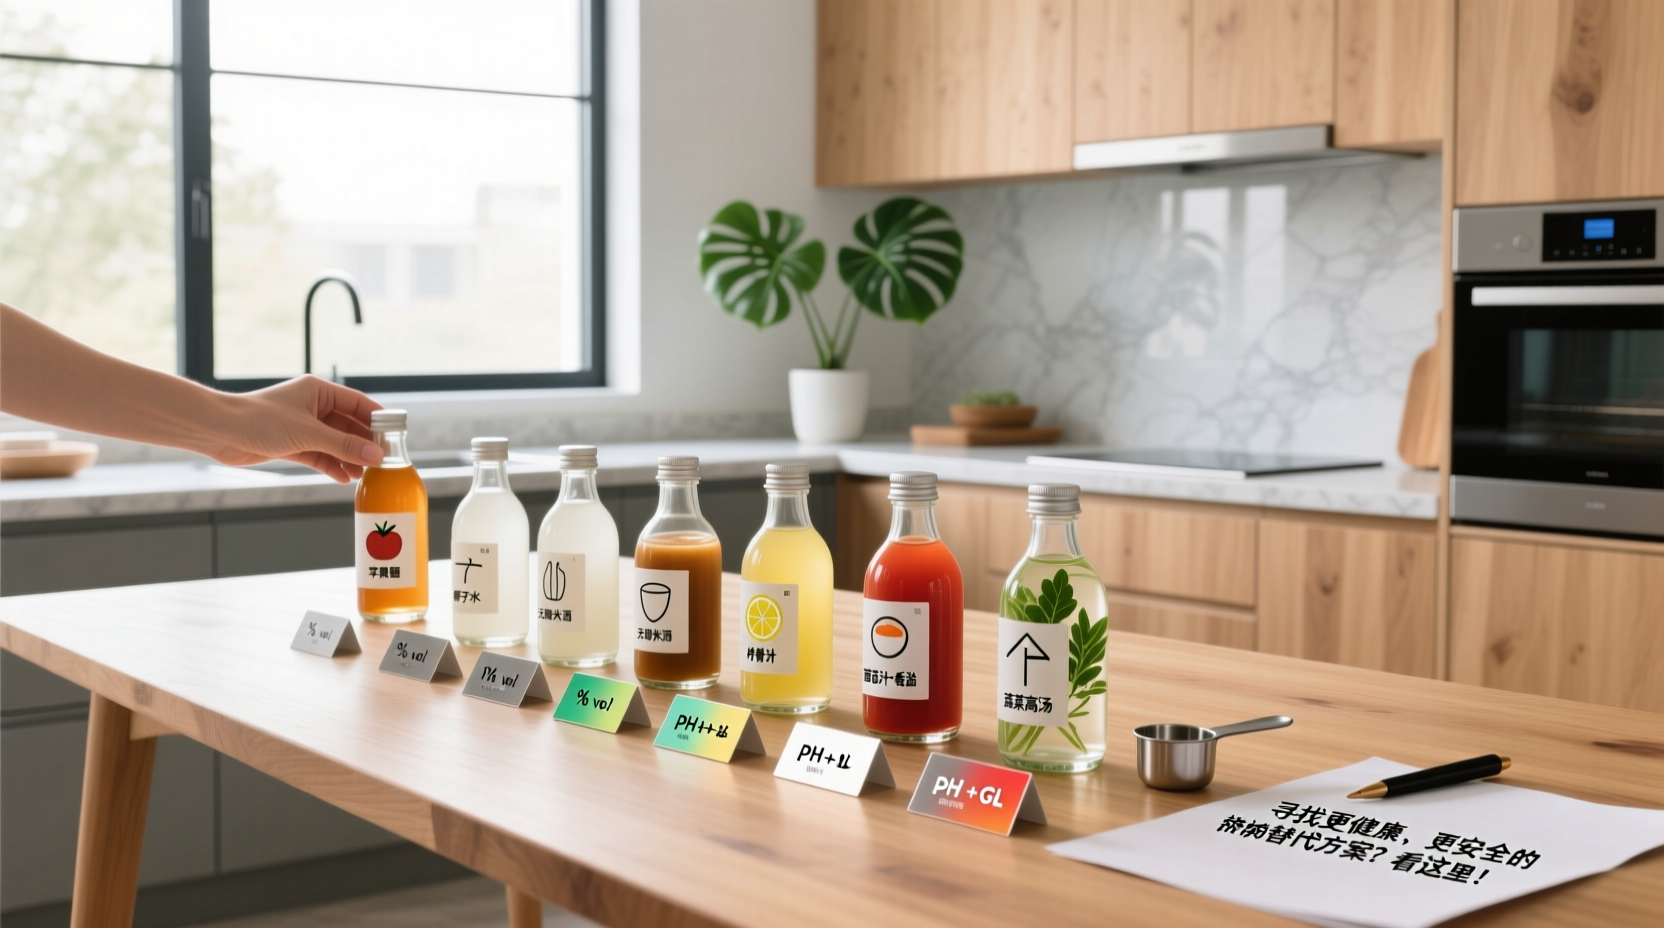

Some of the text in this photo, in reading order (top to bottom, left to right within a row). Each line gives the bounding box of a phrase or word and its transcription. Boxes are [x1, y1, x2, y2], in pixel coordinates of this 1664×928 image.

[576, 688, 614, 712] % vol
[932, 775, 964, 798] PH
